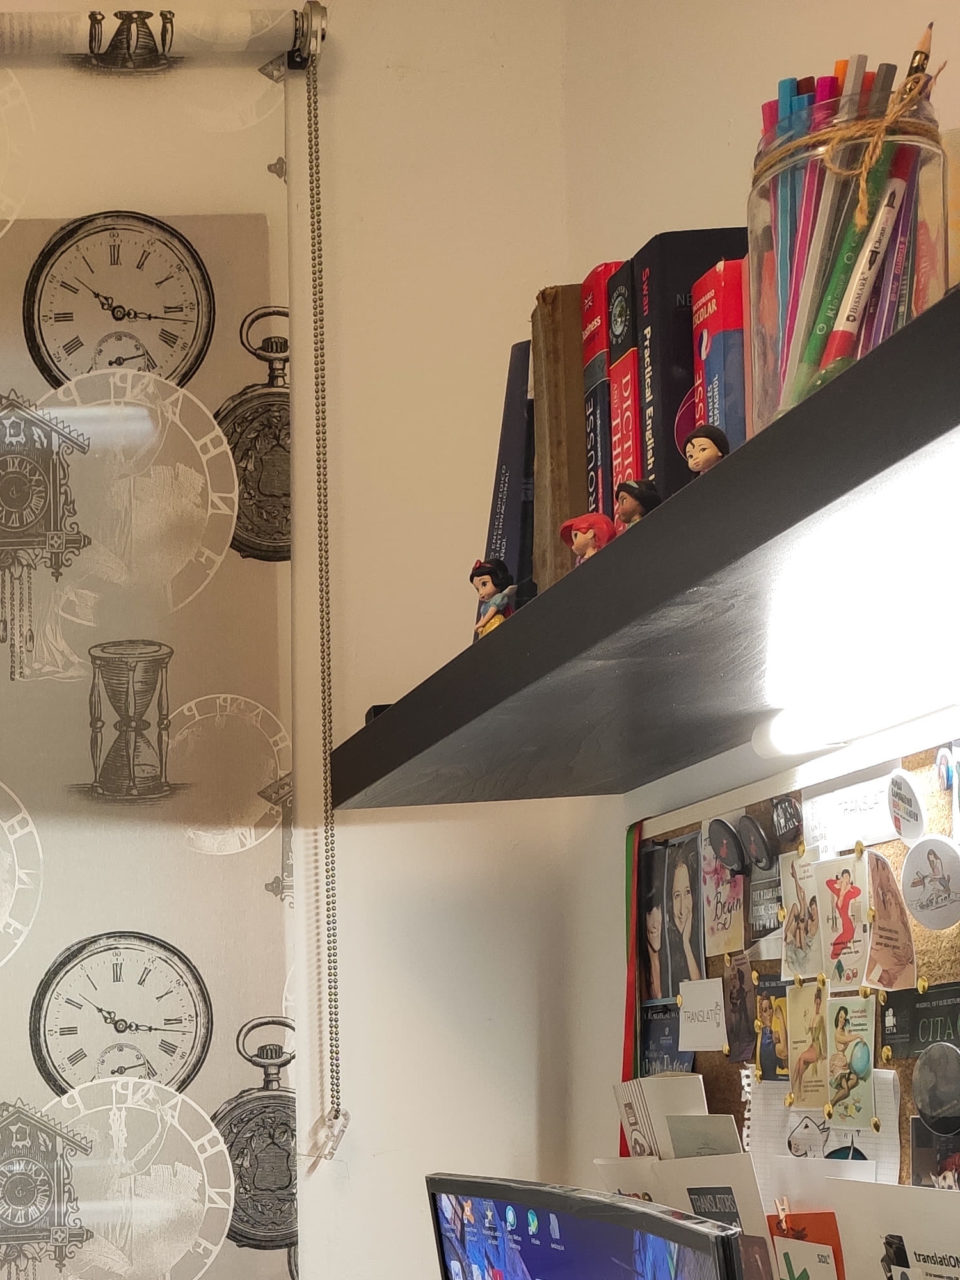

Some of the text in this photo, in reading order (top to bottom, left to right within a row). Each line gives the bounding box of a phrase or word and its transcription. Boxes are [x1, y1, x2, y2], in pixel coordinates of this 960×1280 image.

[642, 268, 650, 316] Swan
[644, 326, 654, 403] Practical
[586, 398, 596, 512] ROUSSE
[645, 406, 656, 471] English
[713, 891, 742, 930] Begin
[919, 1017, 954, 1042] CITA
